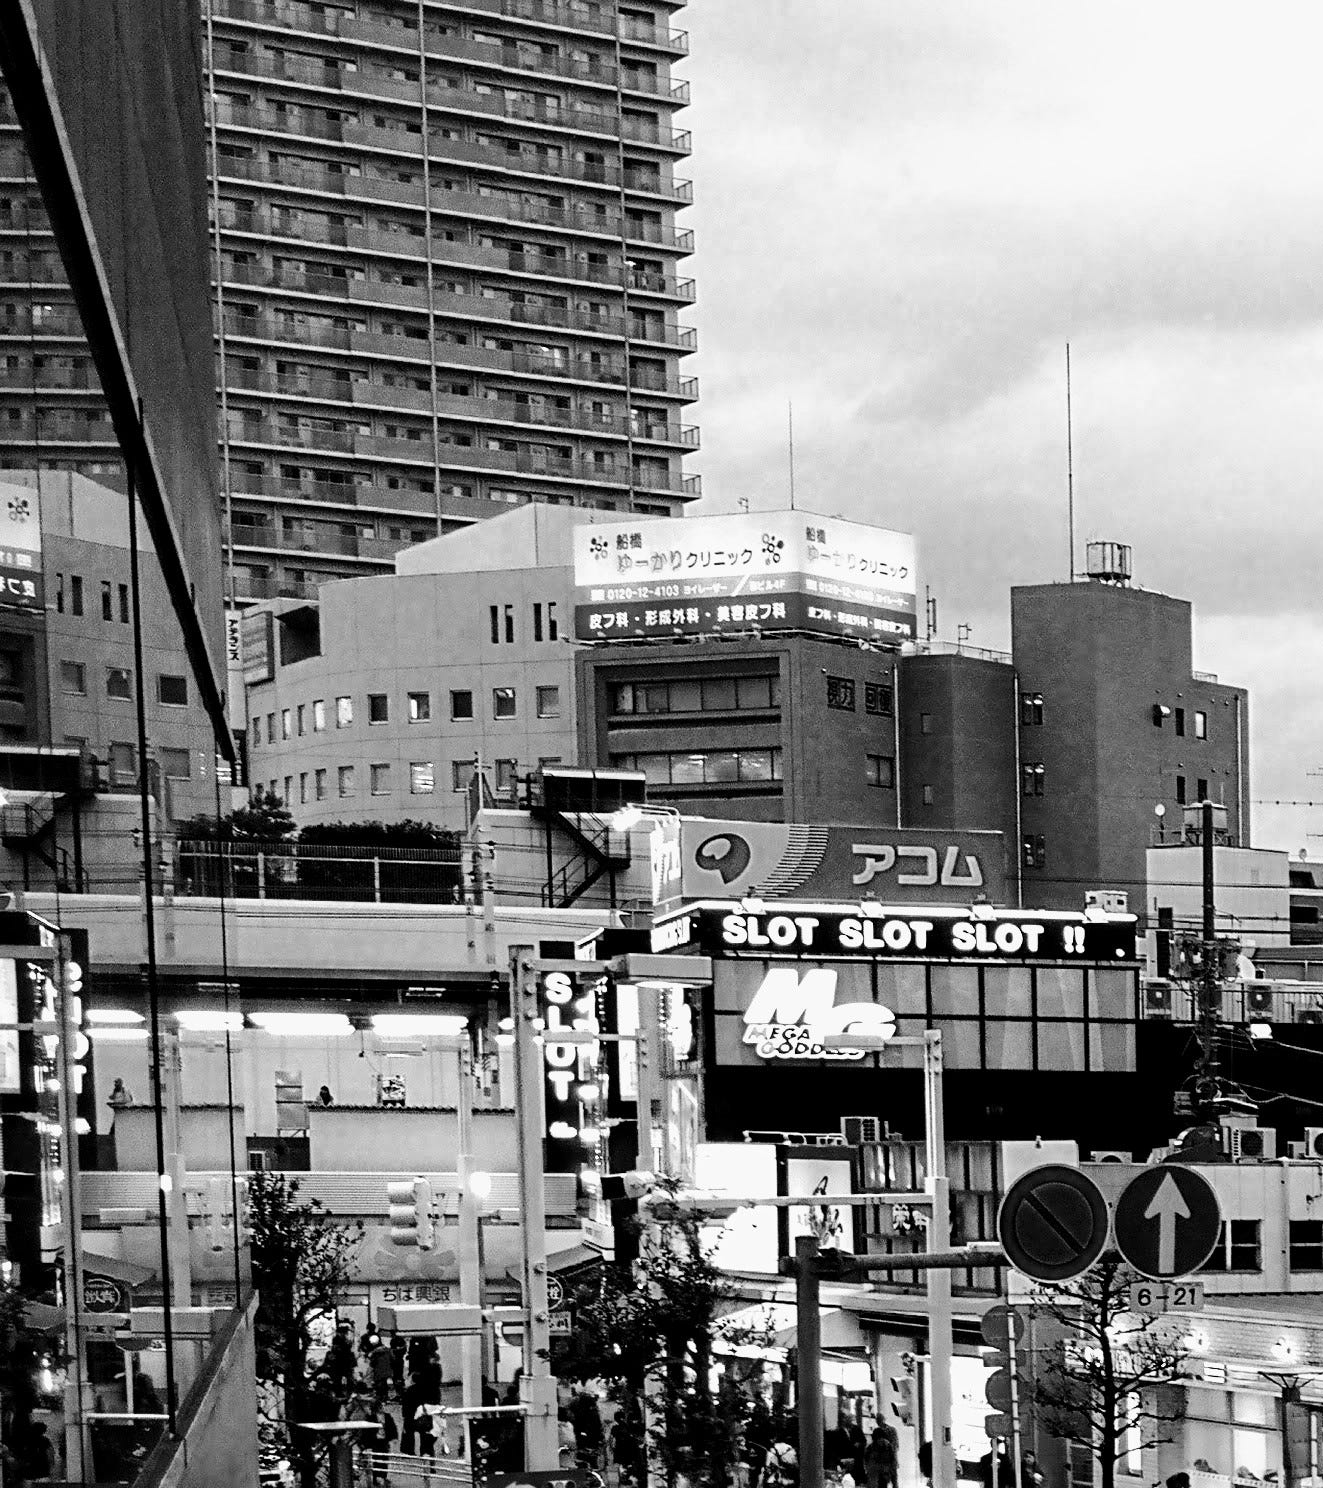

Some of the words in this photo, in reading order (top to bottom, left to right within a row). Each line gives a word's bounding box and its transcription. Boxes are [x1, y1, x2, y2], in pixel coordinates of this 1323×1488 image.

[852, 844, 984, 887] アコム
[722, 915, 820, 948] SLOT
[838, 918, 933, 952] SLOT
[951, 922, 1045, 954] SLOT
